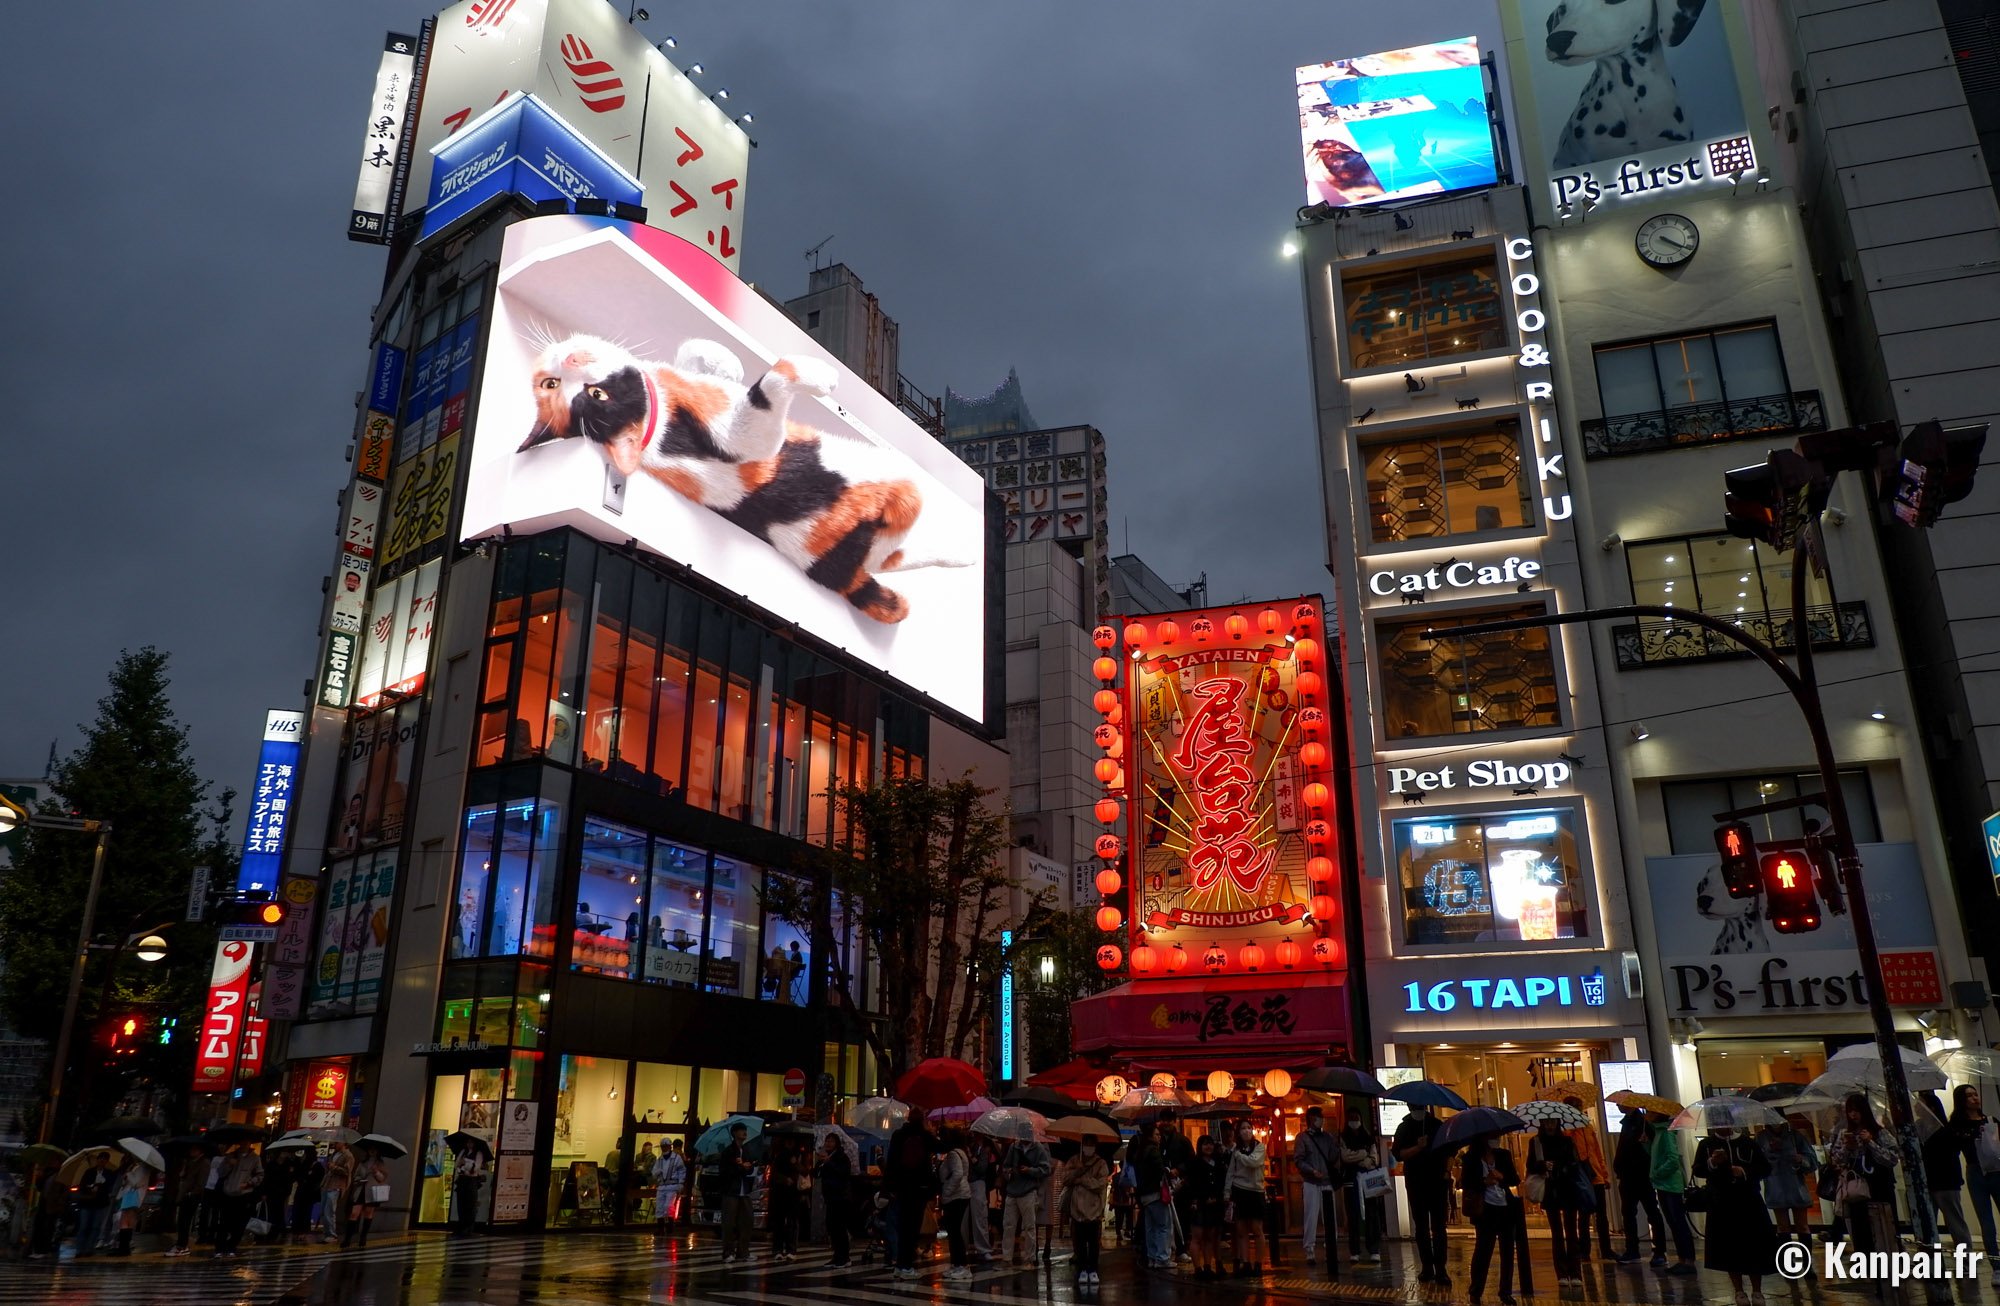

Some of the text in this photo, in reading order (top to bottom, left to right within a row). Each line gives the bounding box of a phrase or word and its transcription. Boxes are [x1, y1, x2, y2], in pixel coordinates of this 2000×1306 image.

[364, 115, 396, 168] 黒木
[1710, 138, 1748, 152] Pets
[1711, 145, 1749, 159] always
[1713, 153, 1751, 166] come
[439, 141, 508, 198] アパマンショップ
[1552, 156, 1704, 209] P's-first
[1714, 159, 1752, 173] first
[1505, 237, 1573, 521] COO&RIKU
[394, 451, 454, 518] ダーツ
[388, 487, 451, 558] グッズ
[352, 545, 365, 554] 4F
[1369, 556, 1541, 595] Cat Cafe
[324, 636, 351, 706] 宝石広場
[1173, 650, 1260, 668] YATAIEN
[269, 720, 300, 733] HIS
[1172, 676, 1276, 894] 屋台苑
[1387, 758, 1571, 794] Pet Shop
[248, 763, 275, 852] エイチ・アイ・エス
[265, 764, 293, 853] 海外・国内旅行
[329, 865, 395, 910] 宝石広場
[1180, 908, 1275, 926] SHINJUKU
[1883, 956, 1933, 966] Pets
[1885, 968, 1935, 978] always
[1403, 975, 1572, 1012] 16 TAPI
[1586, 985, 1601, 996] 16
[1669, 958, 1869, 1012] P's-first
[1887, 980, 1937, 989] come
[1889, 990, 1939, 1000] first
[204, 990, 240, 1059] アコム
[1199, 994, 1299, 1042] 屋台苑
[312, 1067, 346, 1080] ハンバーグ
